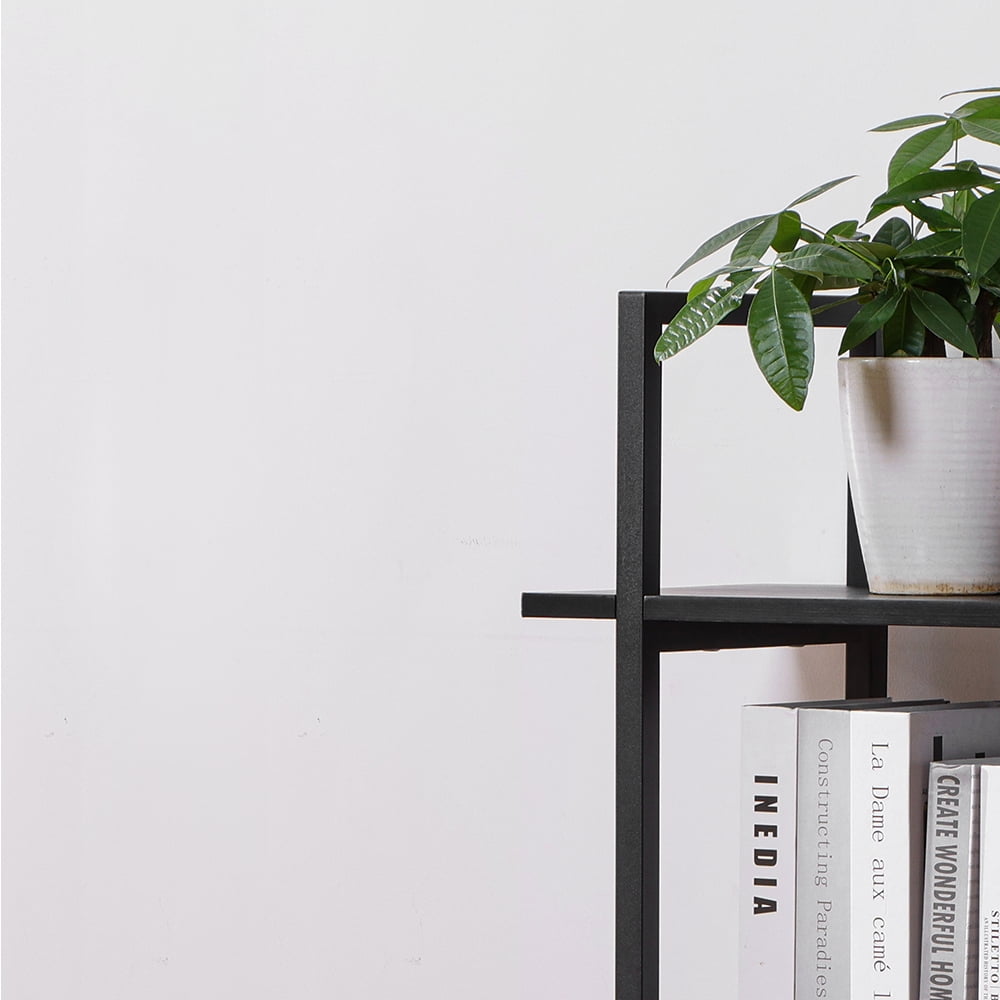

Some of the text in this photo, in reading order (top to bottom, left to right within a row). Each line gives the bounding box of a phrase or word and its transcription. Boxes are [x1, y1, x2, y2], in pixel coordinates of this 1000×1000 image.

[871, 743, 889, 770] La
[871, 785, 890, 843] Dame
[935, 775, 961, 838] CREATE
[753, 775, 778, 915] INEDIA
[814, 738, 834, 998] Constructing Paradies
[872, 858, 885, 900] aux
[931, 845, 957, 953] WONDERFUL
[872, 917, 891, 973] camé
[990, 910, 999, 983] STILETTO
